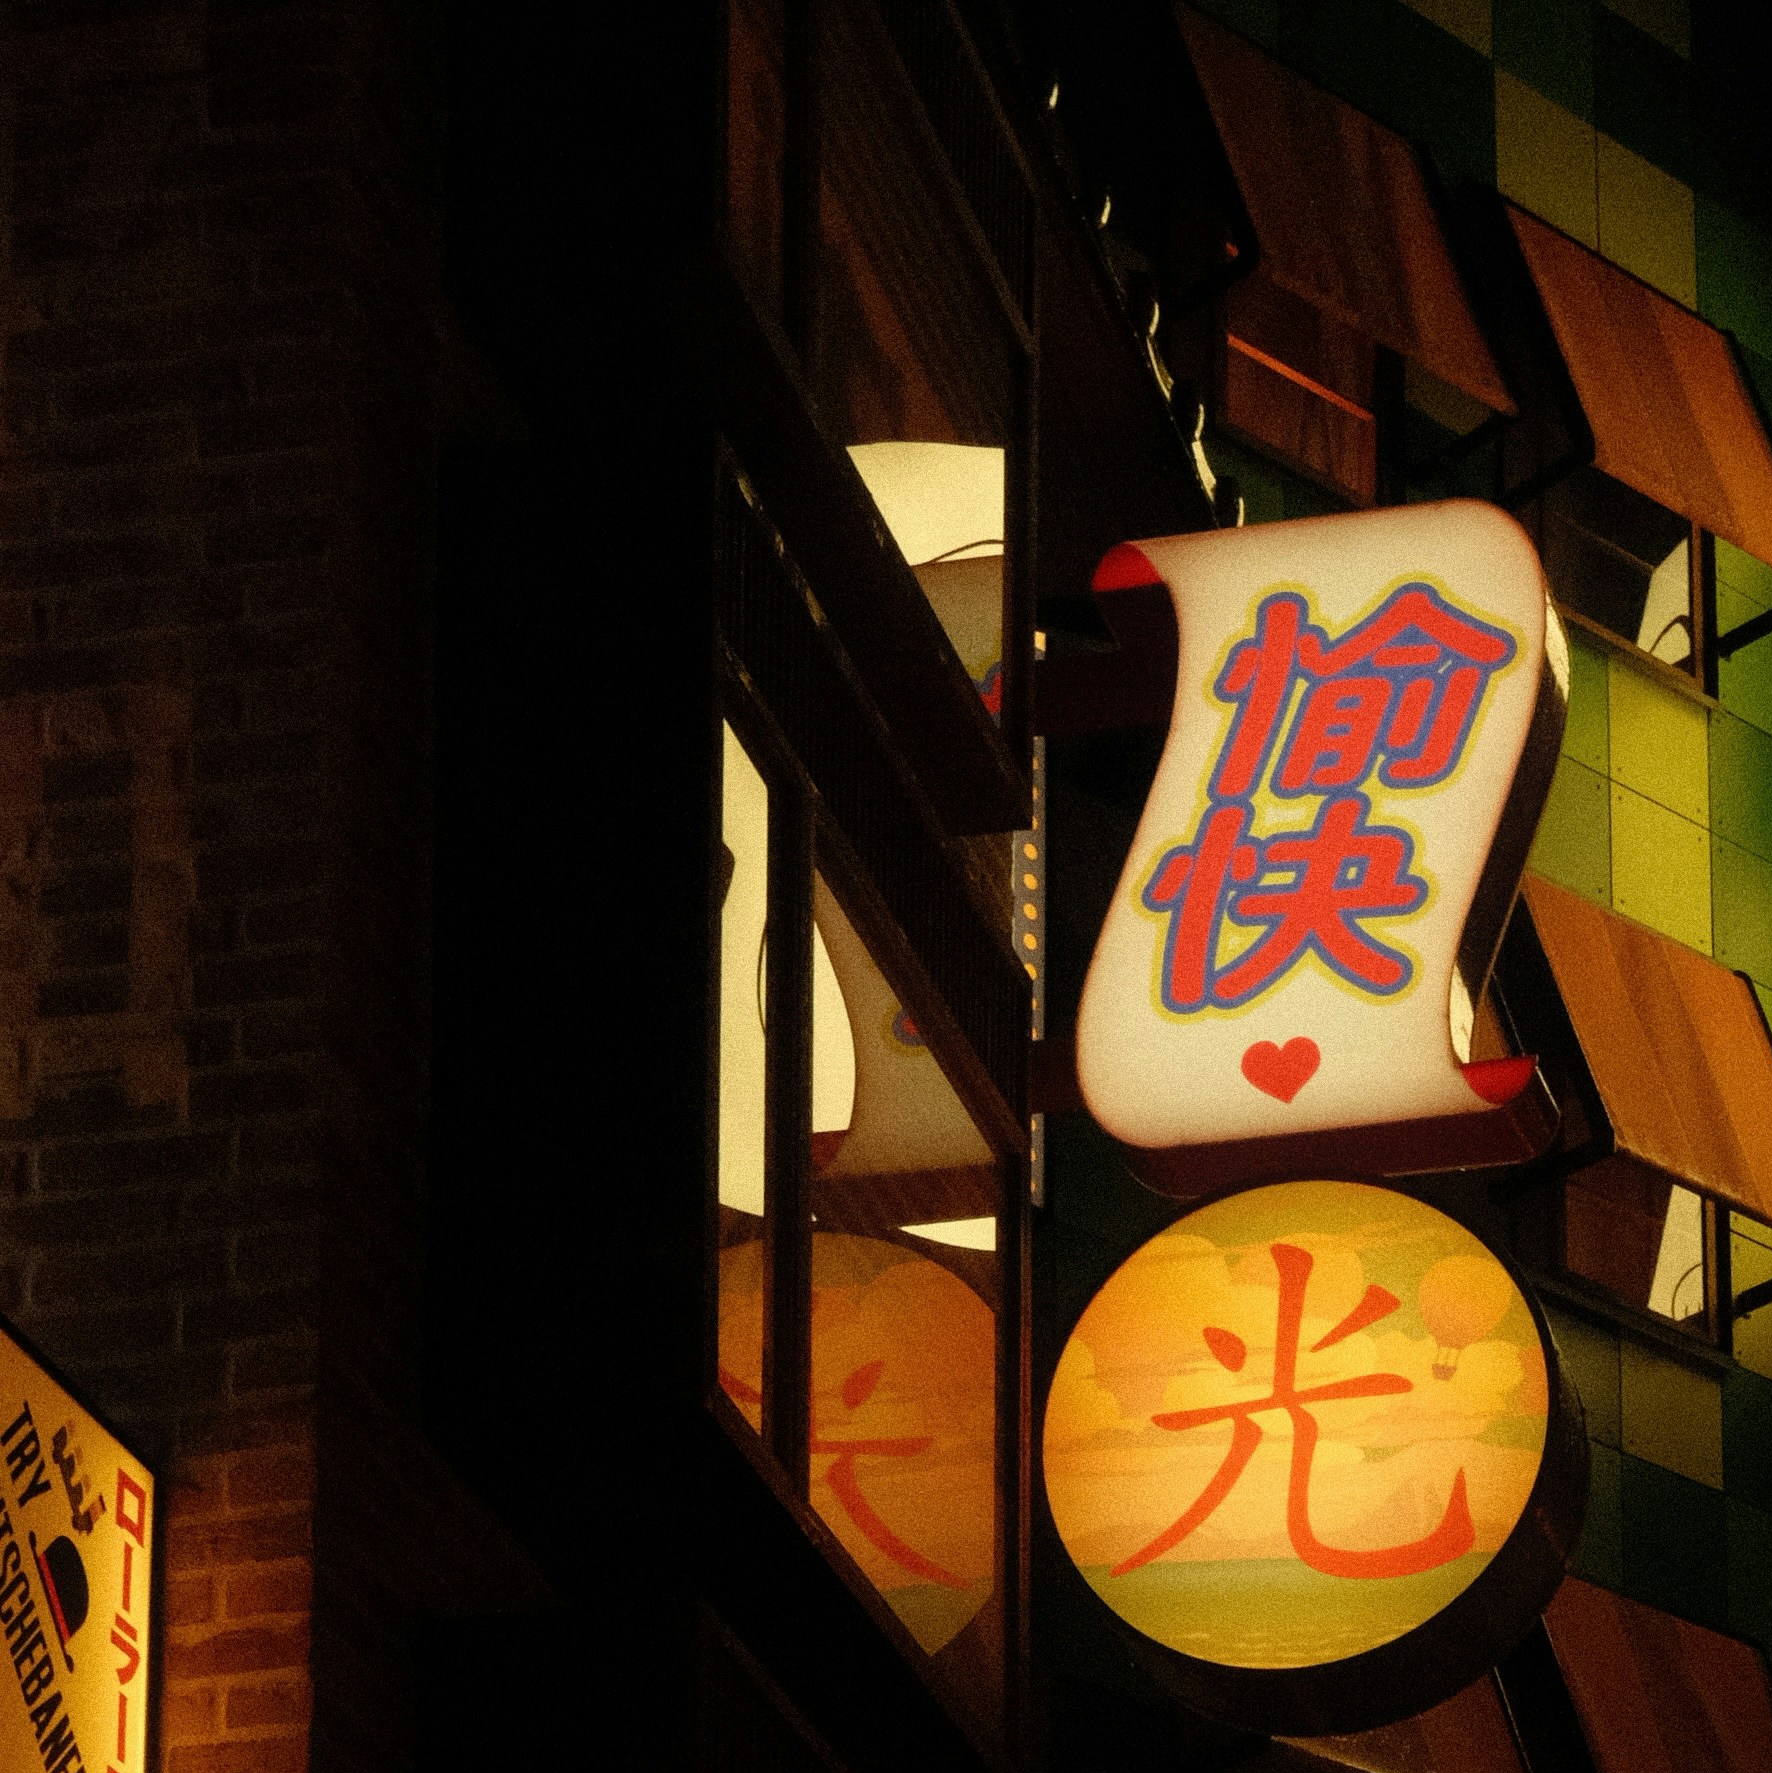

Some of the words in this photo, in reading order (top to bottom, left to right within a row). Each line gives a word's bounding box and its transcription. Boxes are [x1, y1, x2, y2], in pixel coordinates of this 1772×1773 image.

[1143, 575, 1521, 1012] 愉快
[1, 1400, 52, 1509] TRY
[1109, 1243, 1477, 1581] 光
